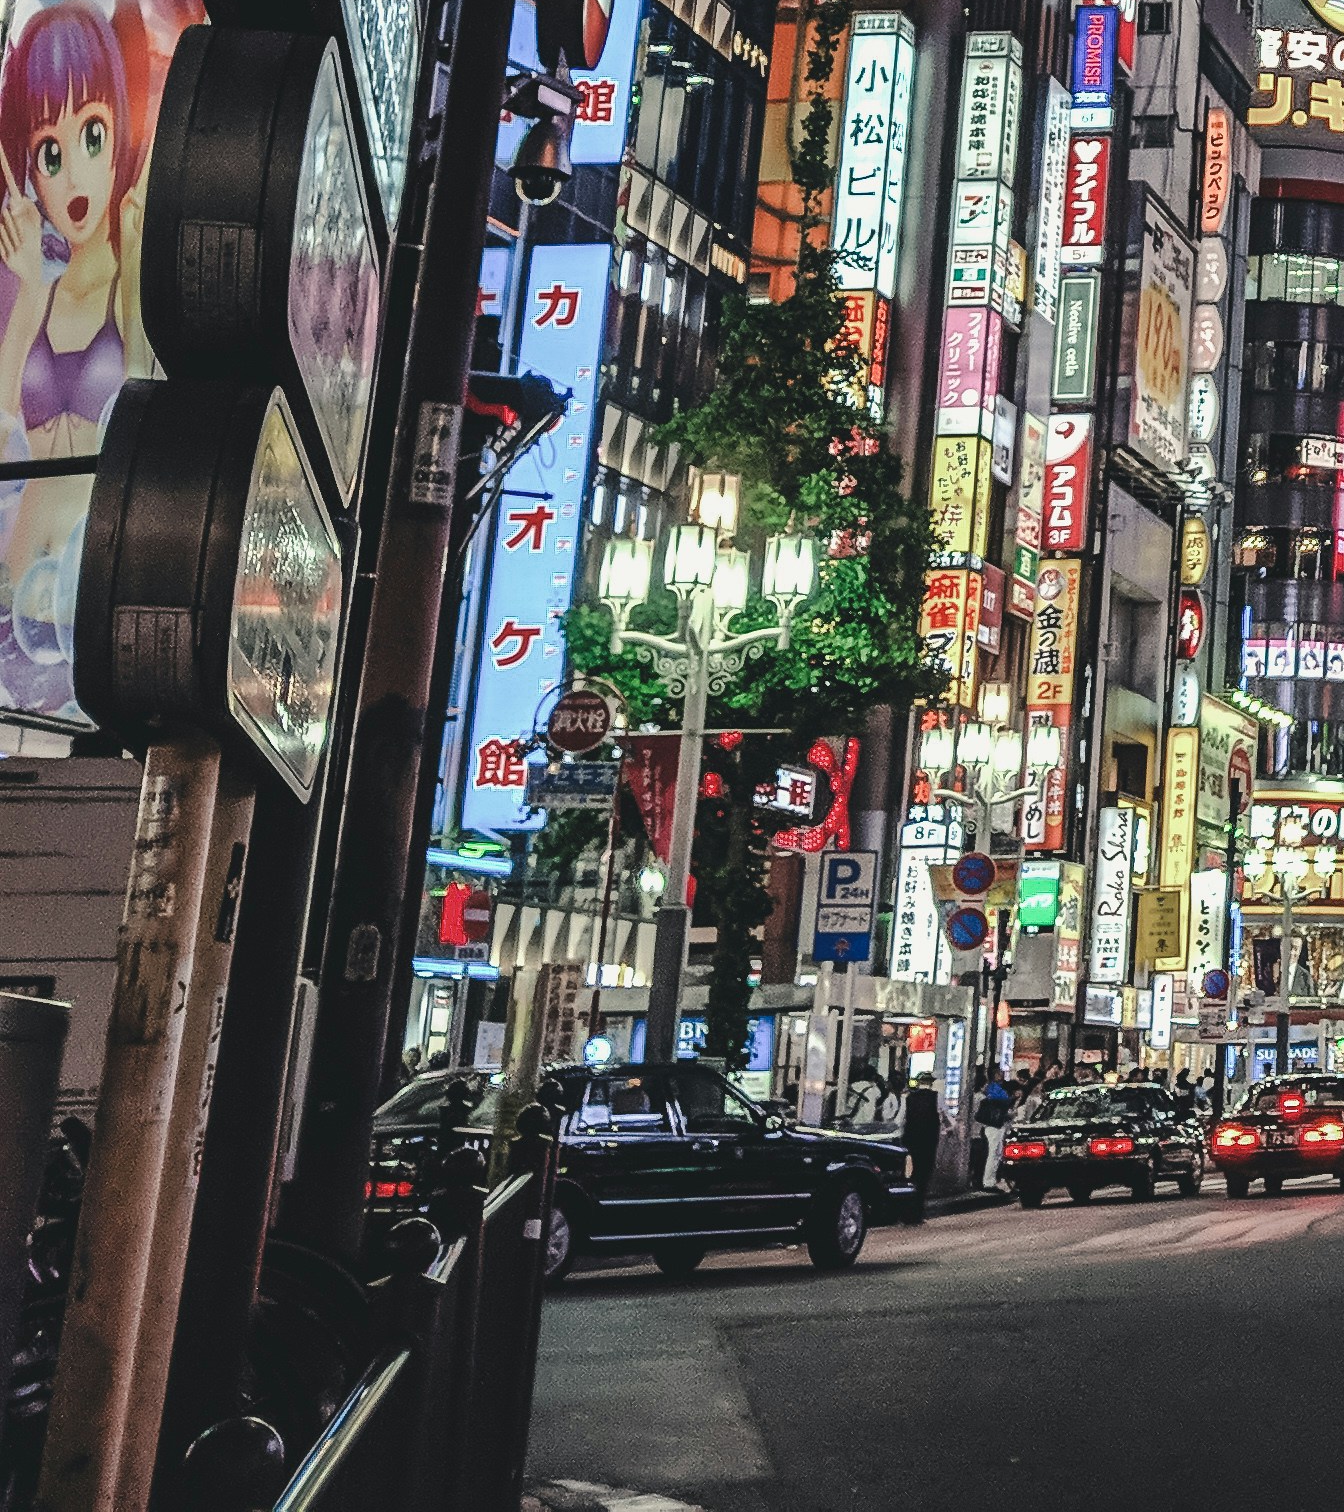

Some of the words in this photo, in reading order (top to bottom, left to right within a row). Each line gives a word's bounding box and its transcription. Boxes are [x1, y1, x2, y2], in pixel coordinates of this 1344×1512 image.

[1083, 12, 1104, 86] PROMISE
[841, 59, 889, 251] 小松ビル
[1069, 162, 1099, 245] アイフル
[943, 331, 964, 406] クリニック
[967, 312, 983, 371] フィラー
[955, 441, 971, 479] お好み
[1047, 465, 1076, 527] アコム
[475, 285, 582, 789] カオケ館
[1048, 529, 1072, 544] 3F
[924, 573, 960, 629] 麻雀
[1032, 603, 1064, 675] 金の蔵
[1037, 681, 1063, 700] 2F
[914, 825, 936, 840] 8F
[826, 858, 861, 899] P
[841, 888, 869, 900] 24H
[1097, 937, 1120, 946] TAX
